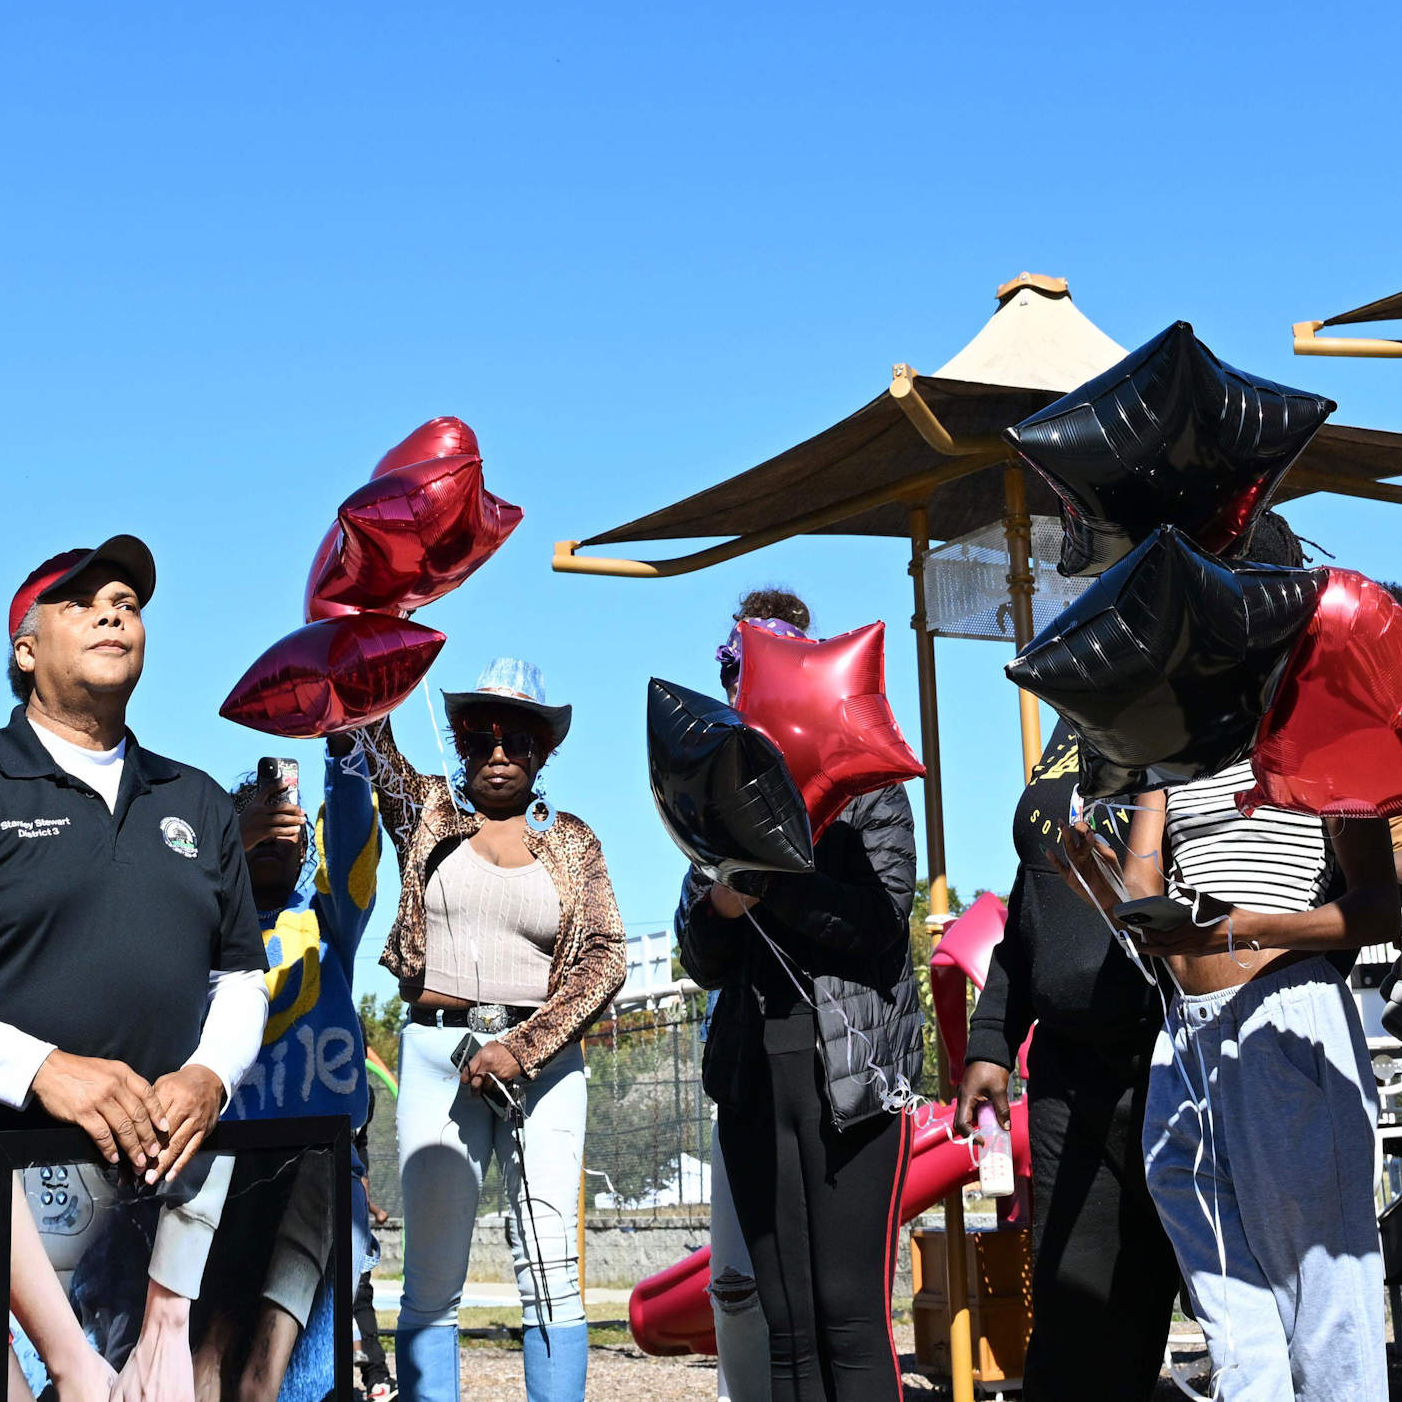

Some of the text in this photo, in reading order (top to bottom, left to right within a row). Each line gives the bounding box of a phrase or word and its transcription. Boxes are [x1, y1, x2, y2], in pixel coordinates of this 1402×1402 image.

[0, 817, 71, 830] Stanley Stewart
[18, 827, 60, 838] District 3
